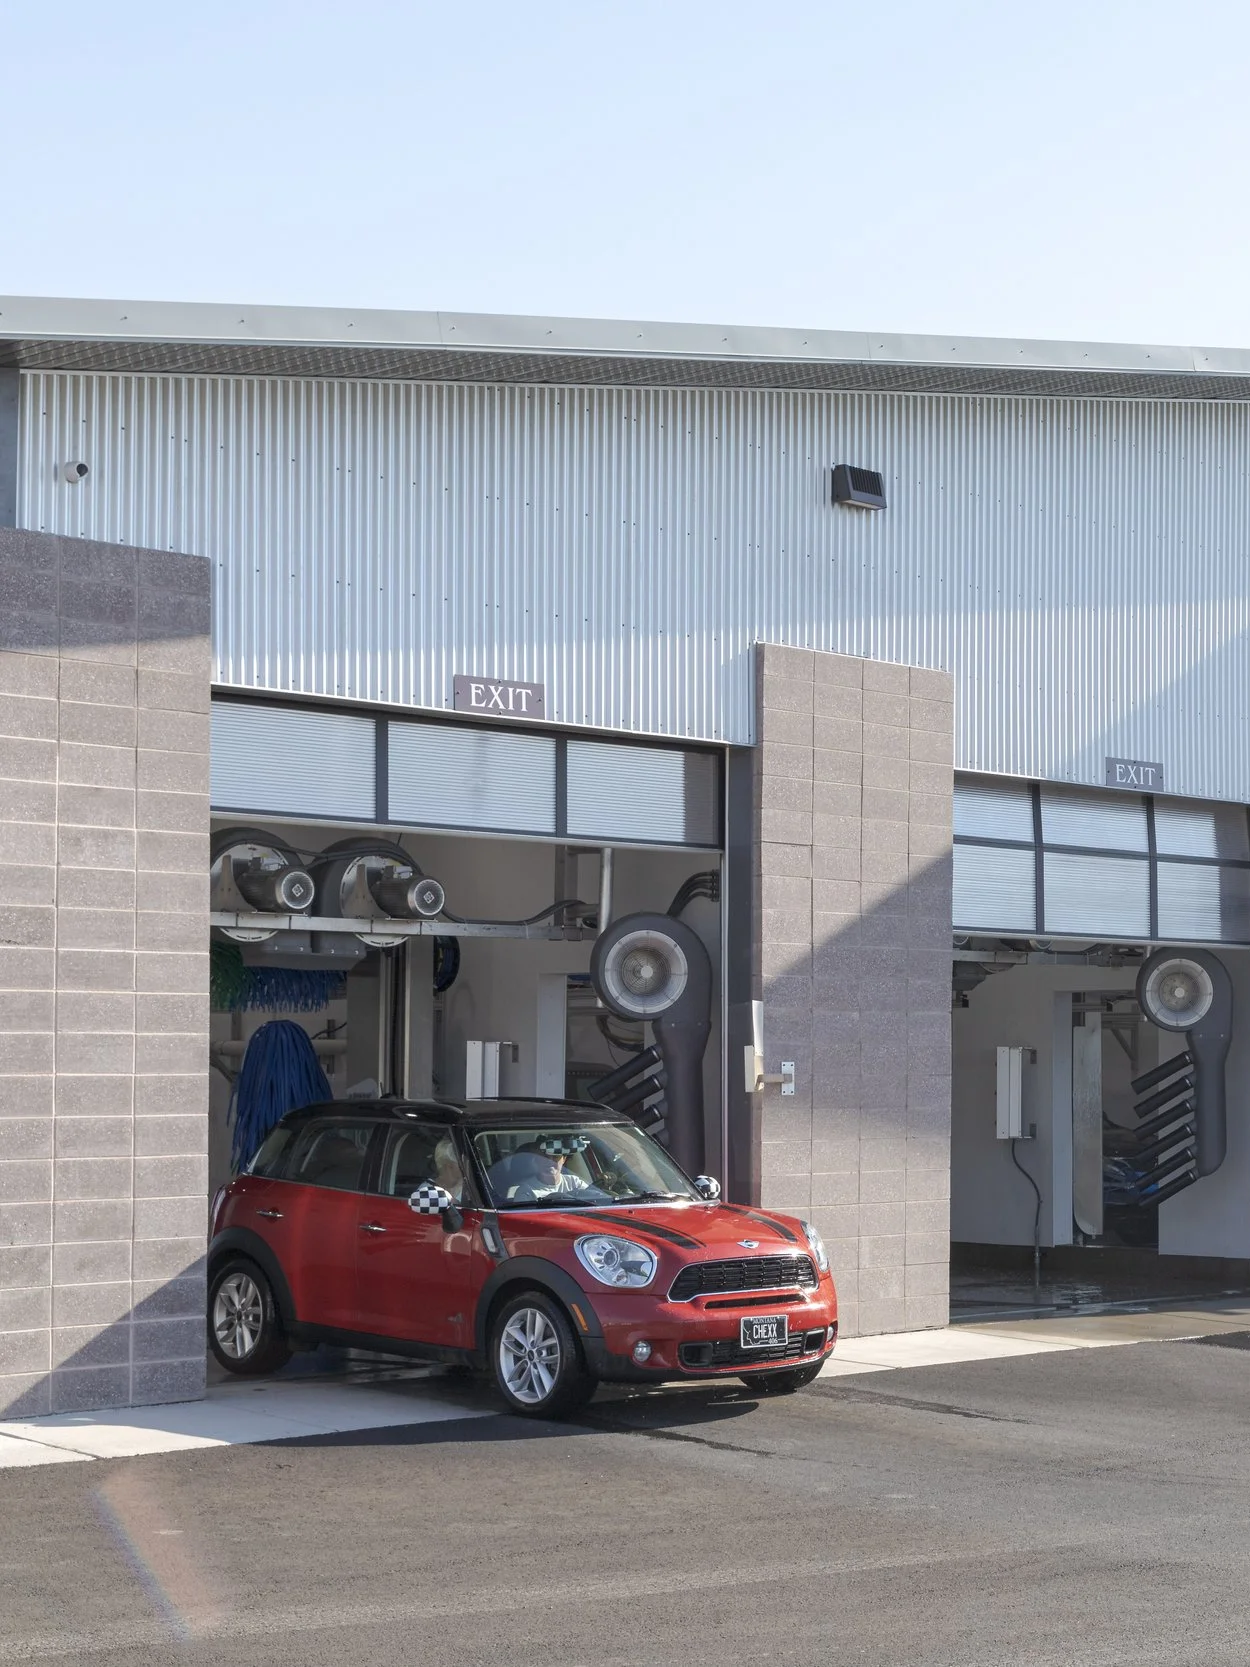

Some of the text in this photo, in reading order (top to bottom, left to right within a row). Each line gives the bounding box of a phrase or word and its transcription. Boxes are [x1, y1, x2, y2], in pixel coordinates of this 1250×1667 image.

[470, 683, 532, 712] EXIT
[1115, 764, 1156, 786] EXIT
[753, 1324, 777, 1338] CHEXX
